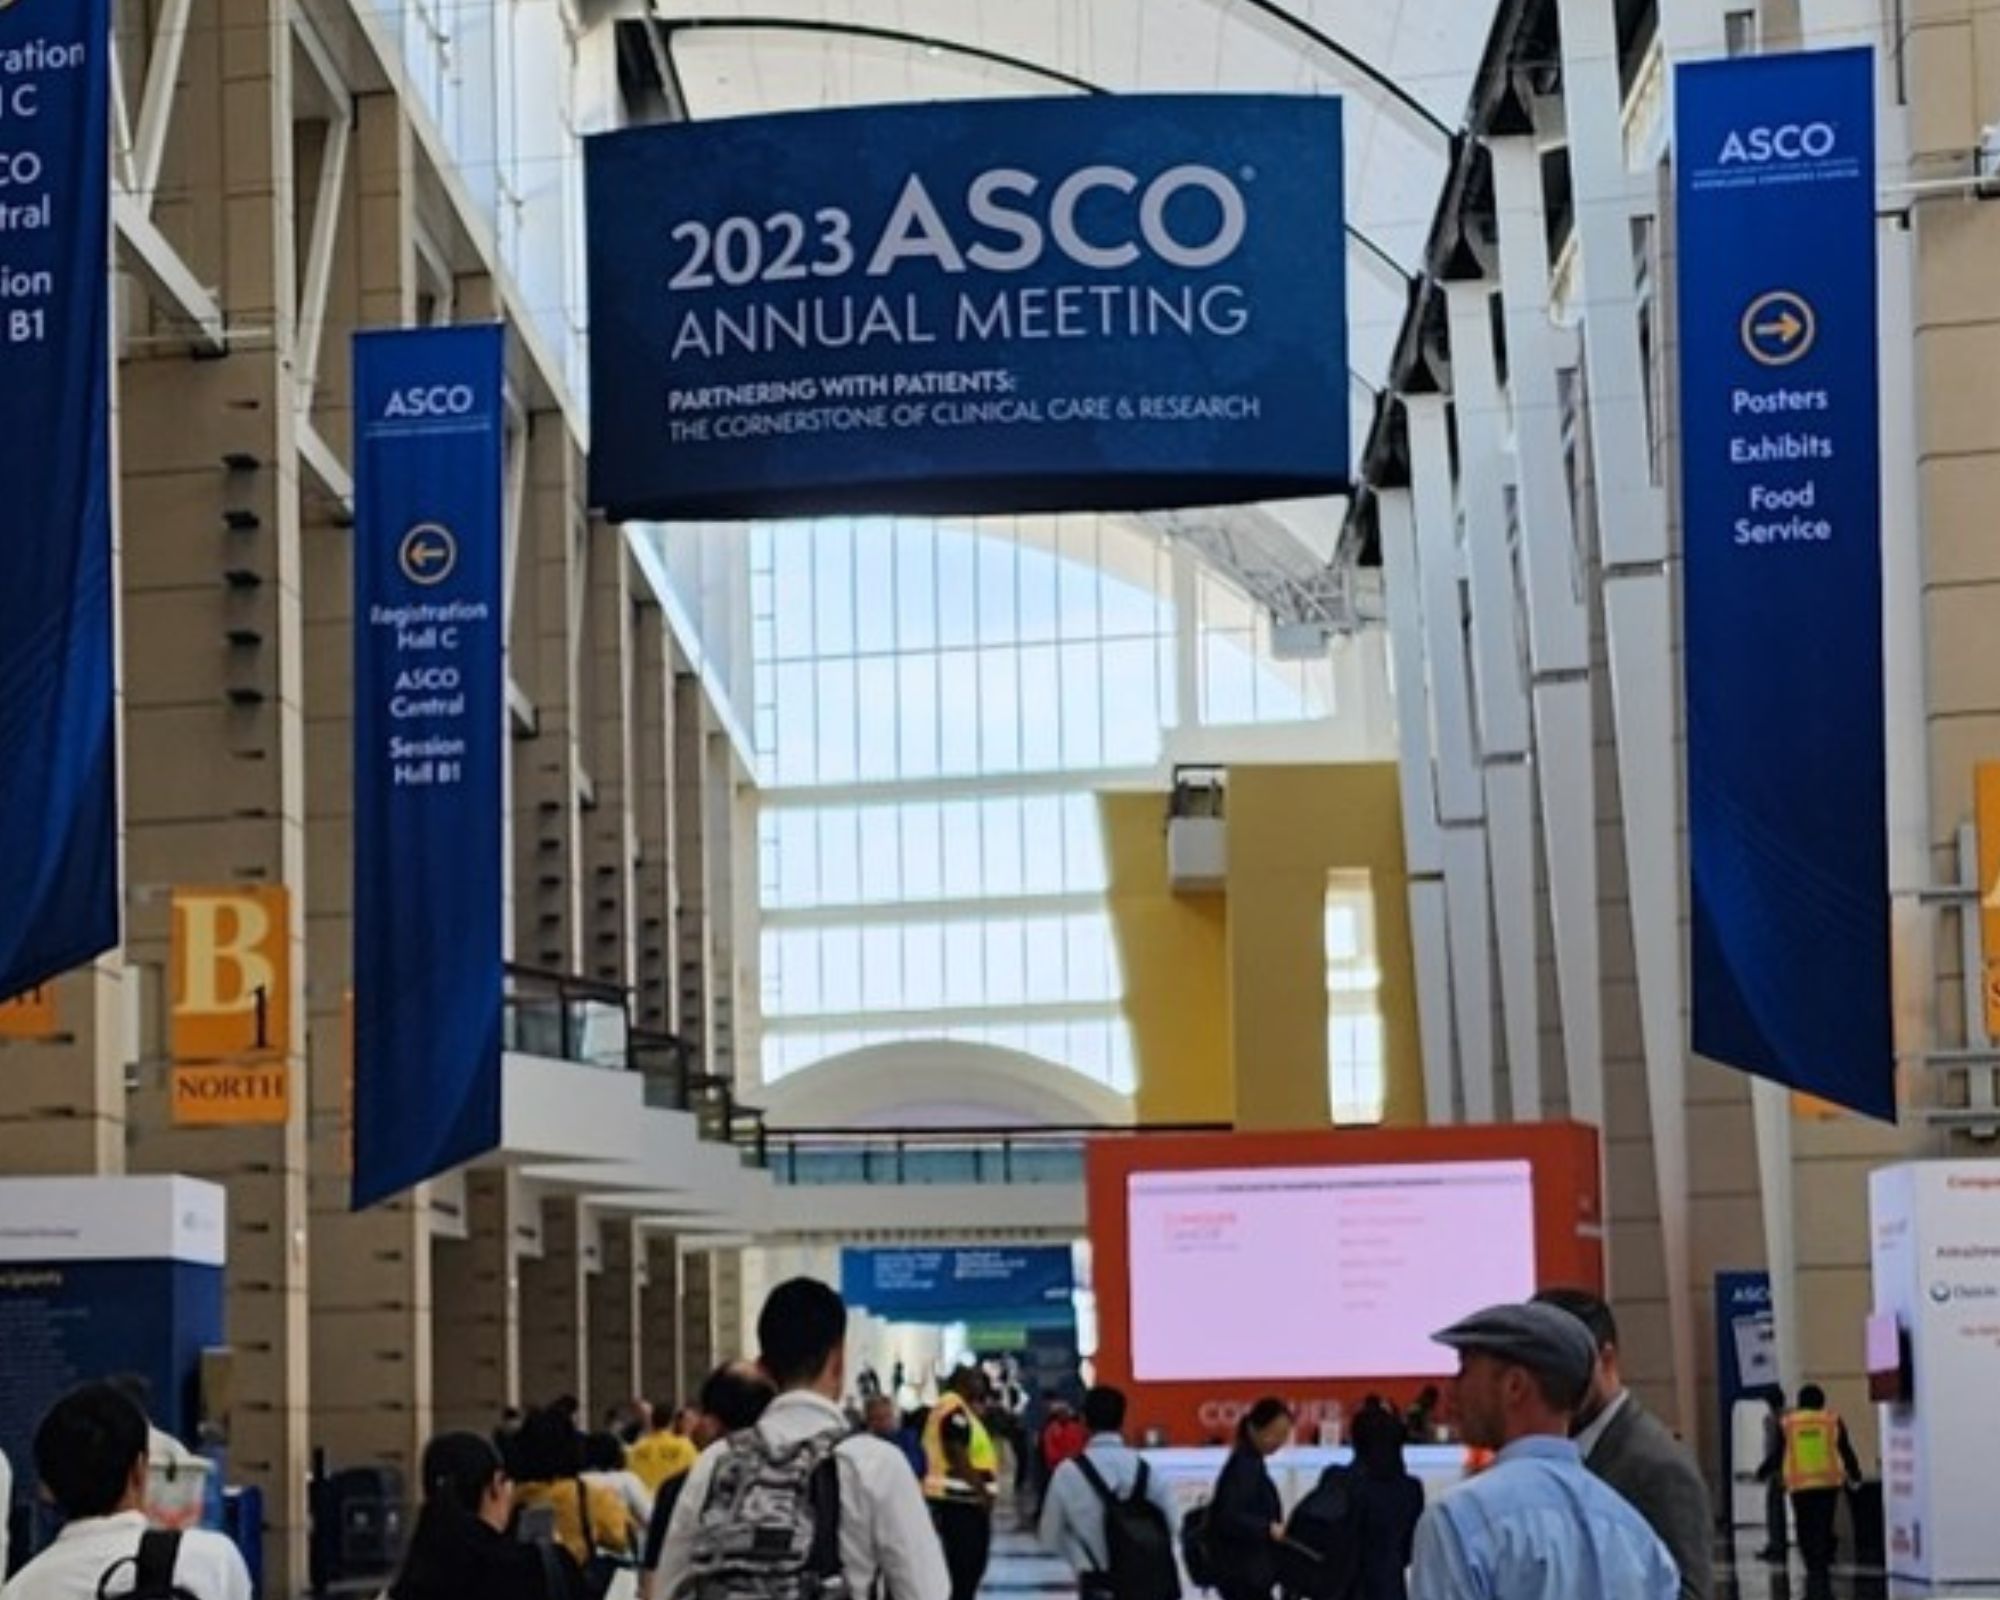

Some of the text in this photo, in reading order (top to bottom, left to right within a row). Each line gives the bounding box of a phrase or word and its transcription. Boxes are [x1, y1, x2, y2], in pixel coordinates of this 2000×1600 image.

[1717, 121, 1836, 165] ASCO
[668, 207, 854, 291] 2023
[8, 307, 44, 341] B1
[671, 285, 1249, 361] ANNUAL MEETING
[383, 384, 475, 418] ASCO
[668, 370, 1016, 412] PARTNERING WITH PATIENTS:
[1732, 387, 1829, 415] Posters
[669, 395, 1261, 442] THE CORNERSTONE OF CLINICAL CARE & RESEARCH
[1730, 431, 1833, 463] Exhibits
[1750, 480, 1815, 511] Food
[1733, 514, 1832, 545] Service
[370, 602, 489, 629] Registration
[397, 626, 460, 650] Hall C
[394, 666, 461, 691] ASCO
[388, 691, 465, 718] Central
[388, 735, 466, 759] Session
[393, 761, 462, 785] Hall B1
[177, 1074, 284, 1099] NORTH
